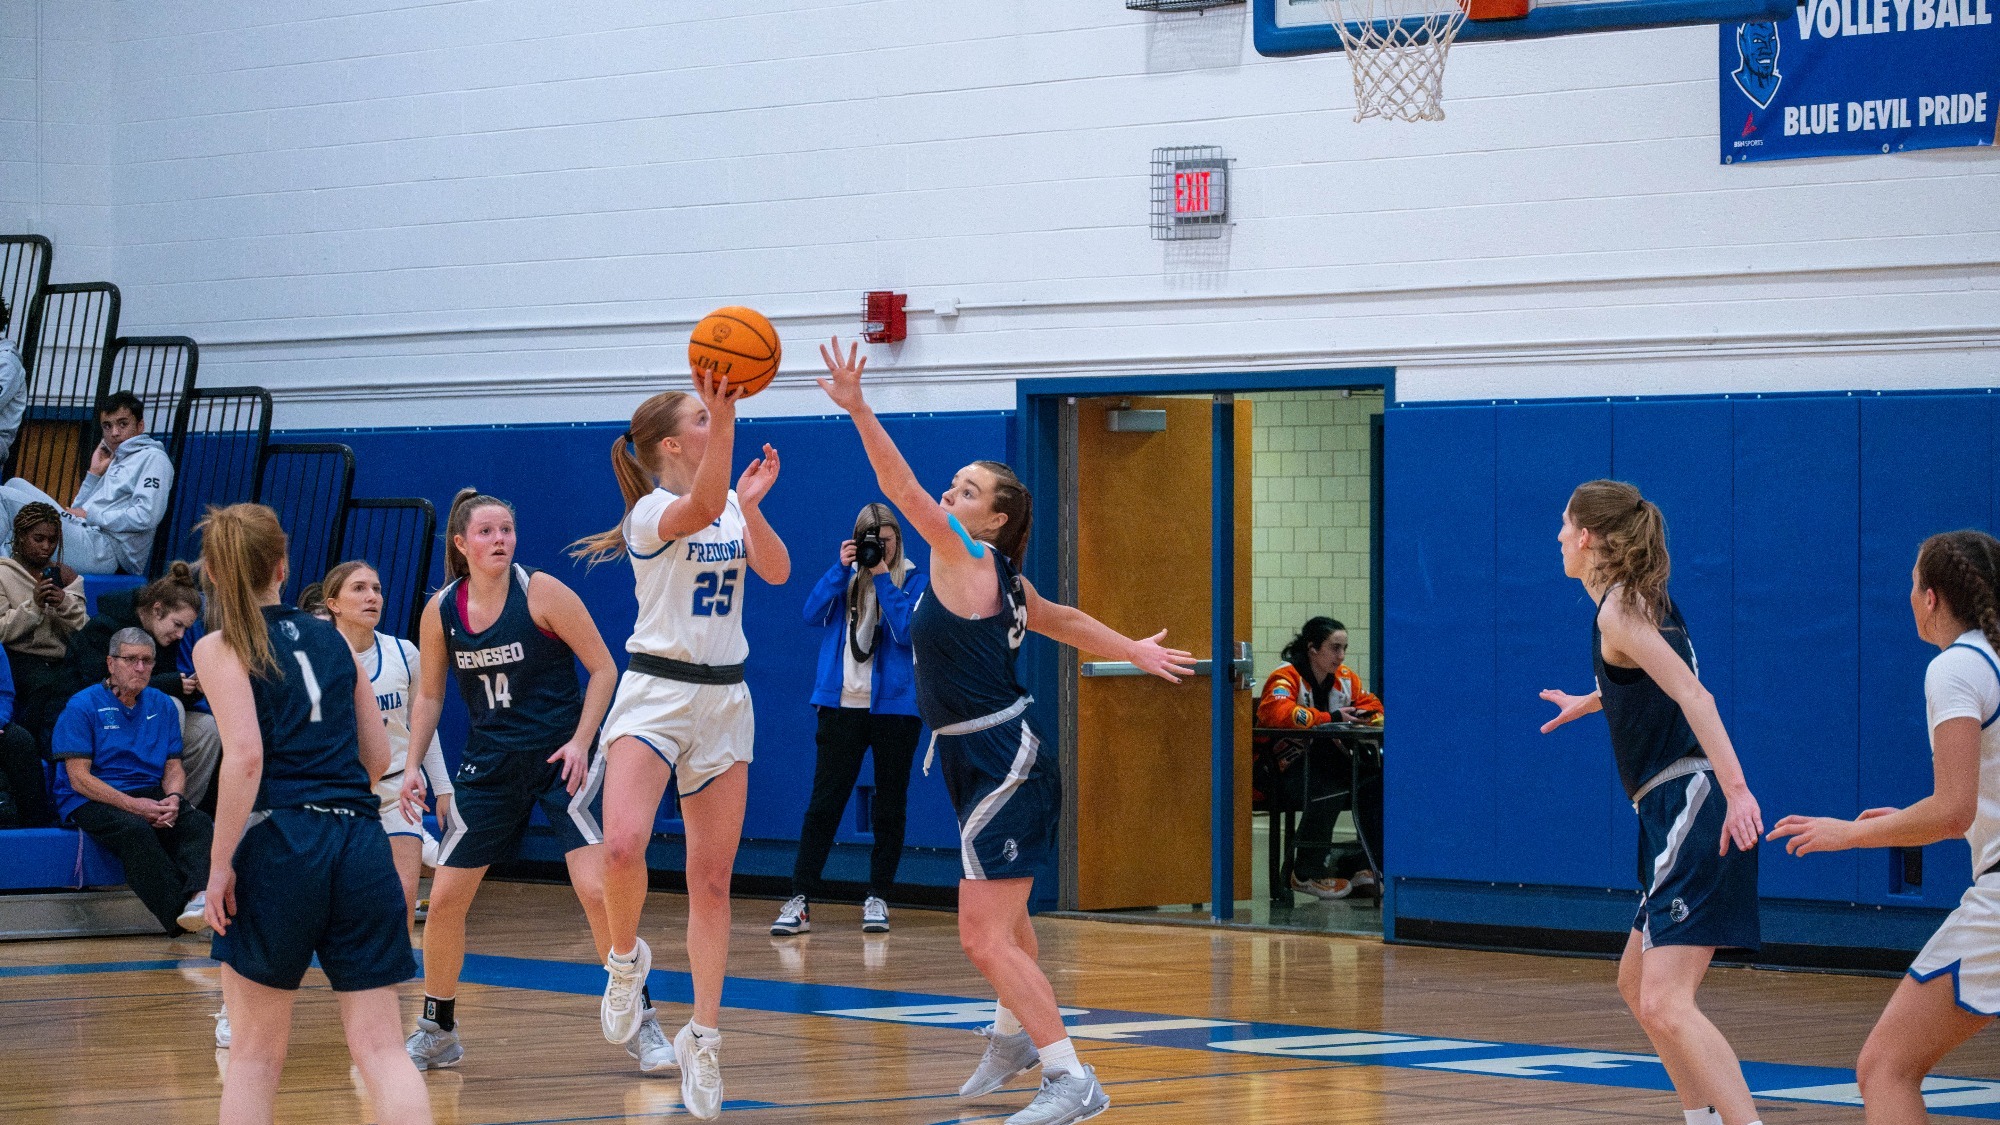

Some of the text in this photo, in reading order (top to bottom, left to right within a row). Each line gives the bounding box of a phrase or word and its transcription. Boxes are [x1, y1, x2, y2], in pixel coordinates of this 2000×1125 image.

[1796, 0, 1992, 40] VOLLEYBALL
[1784, 92, 1987, 136] BLUE DEVIL PRIDE
[1175, 171, 1210, 213] EXIT
[143, 477, 160, 489] 25
[691, 568, 738, 617] 25
[455, 641, 525, 670] GENESEO
[293, 650, 322, 722] 1
[478, 672, 513, 710] 14
